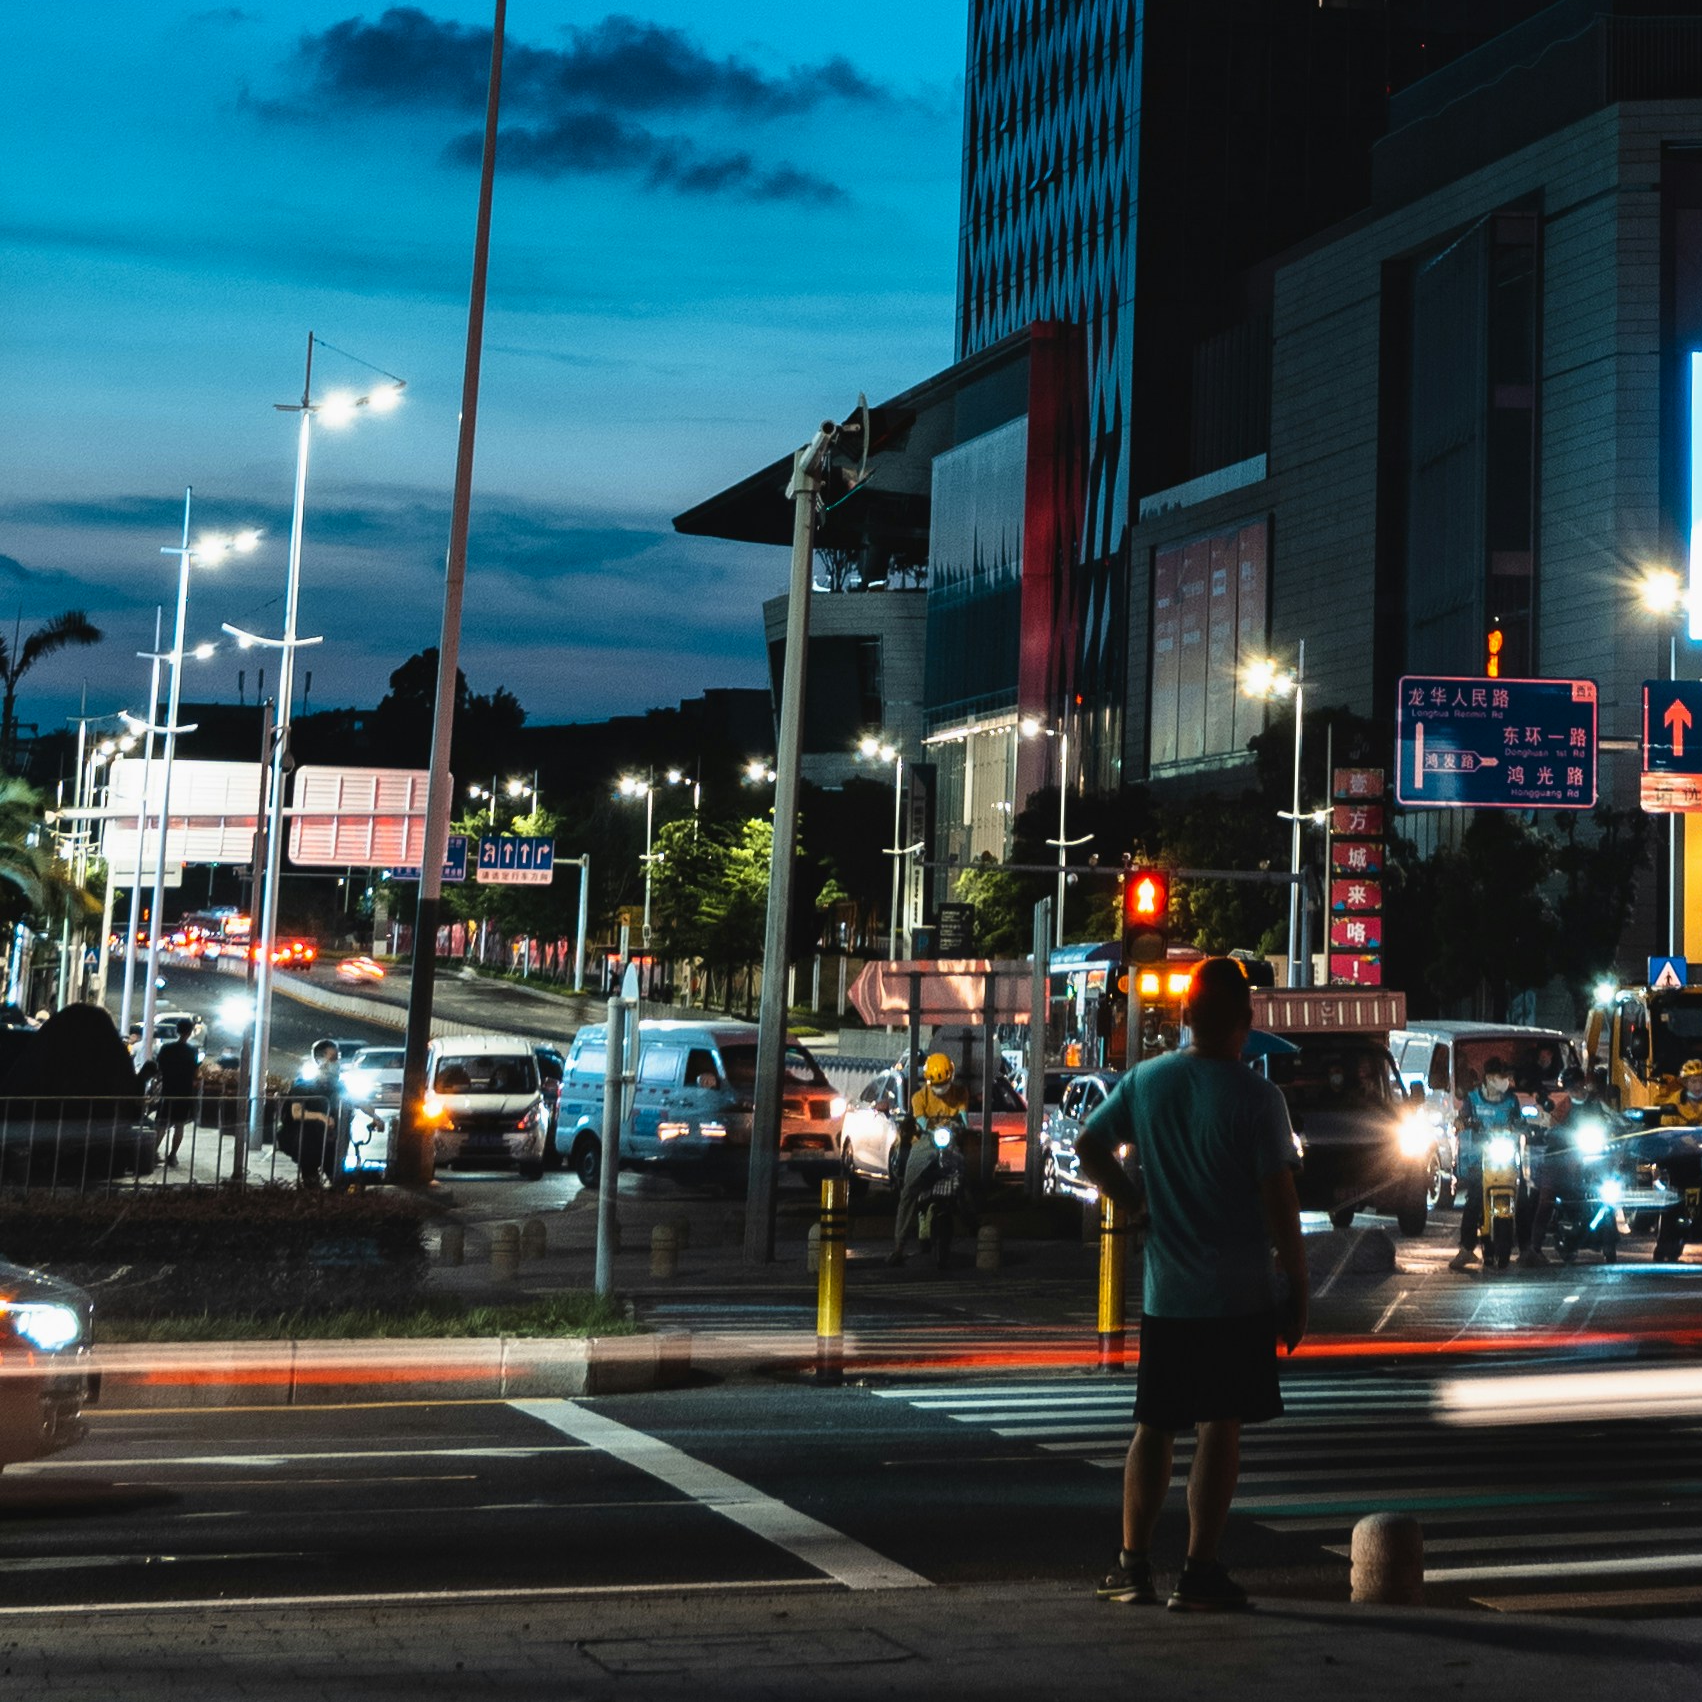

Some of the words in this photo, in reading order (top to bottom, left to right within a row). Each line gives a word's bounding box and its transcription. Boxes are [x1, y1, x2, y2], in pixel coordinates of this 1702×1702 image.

[1408, 687, 1510, 709] 龙华人民路
[1412, 709, 1449, 720] Longhua
[1454, 710, 1486, 719] Renmin
[1491, 710, 1504, 720] Rd
[1503, 726, 1587, 747] 东环一路
[1425, 753, 1475, 770] 鸿发路
[1505, 747, 1549, 759] Donghuan
[1556, 749, 1567, 758] 1st
[1573, 749, 1586, 758] Rd
[1507, 765, 1585, 787] 鸿光路
[1511, 789, 1563, 801] Hongguang
[1567, 789, 1580, 799] Rd
